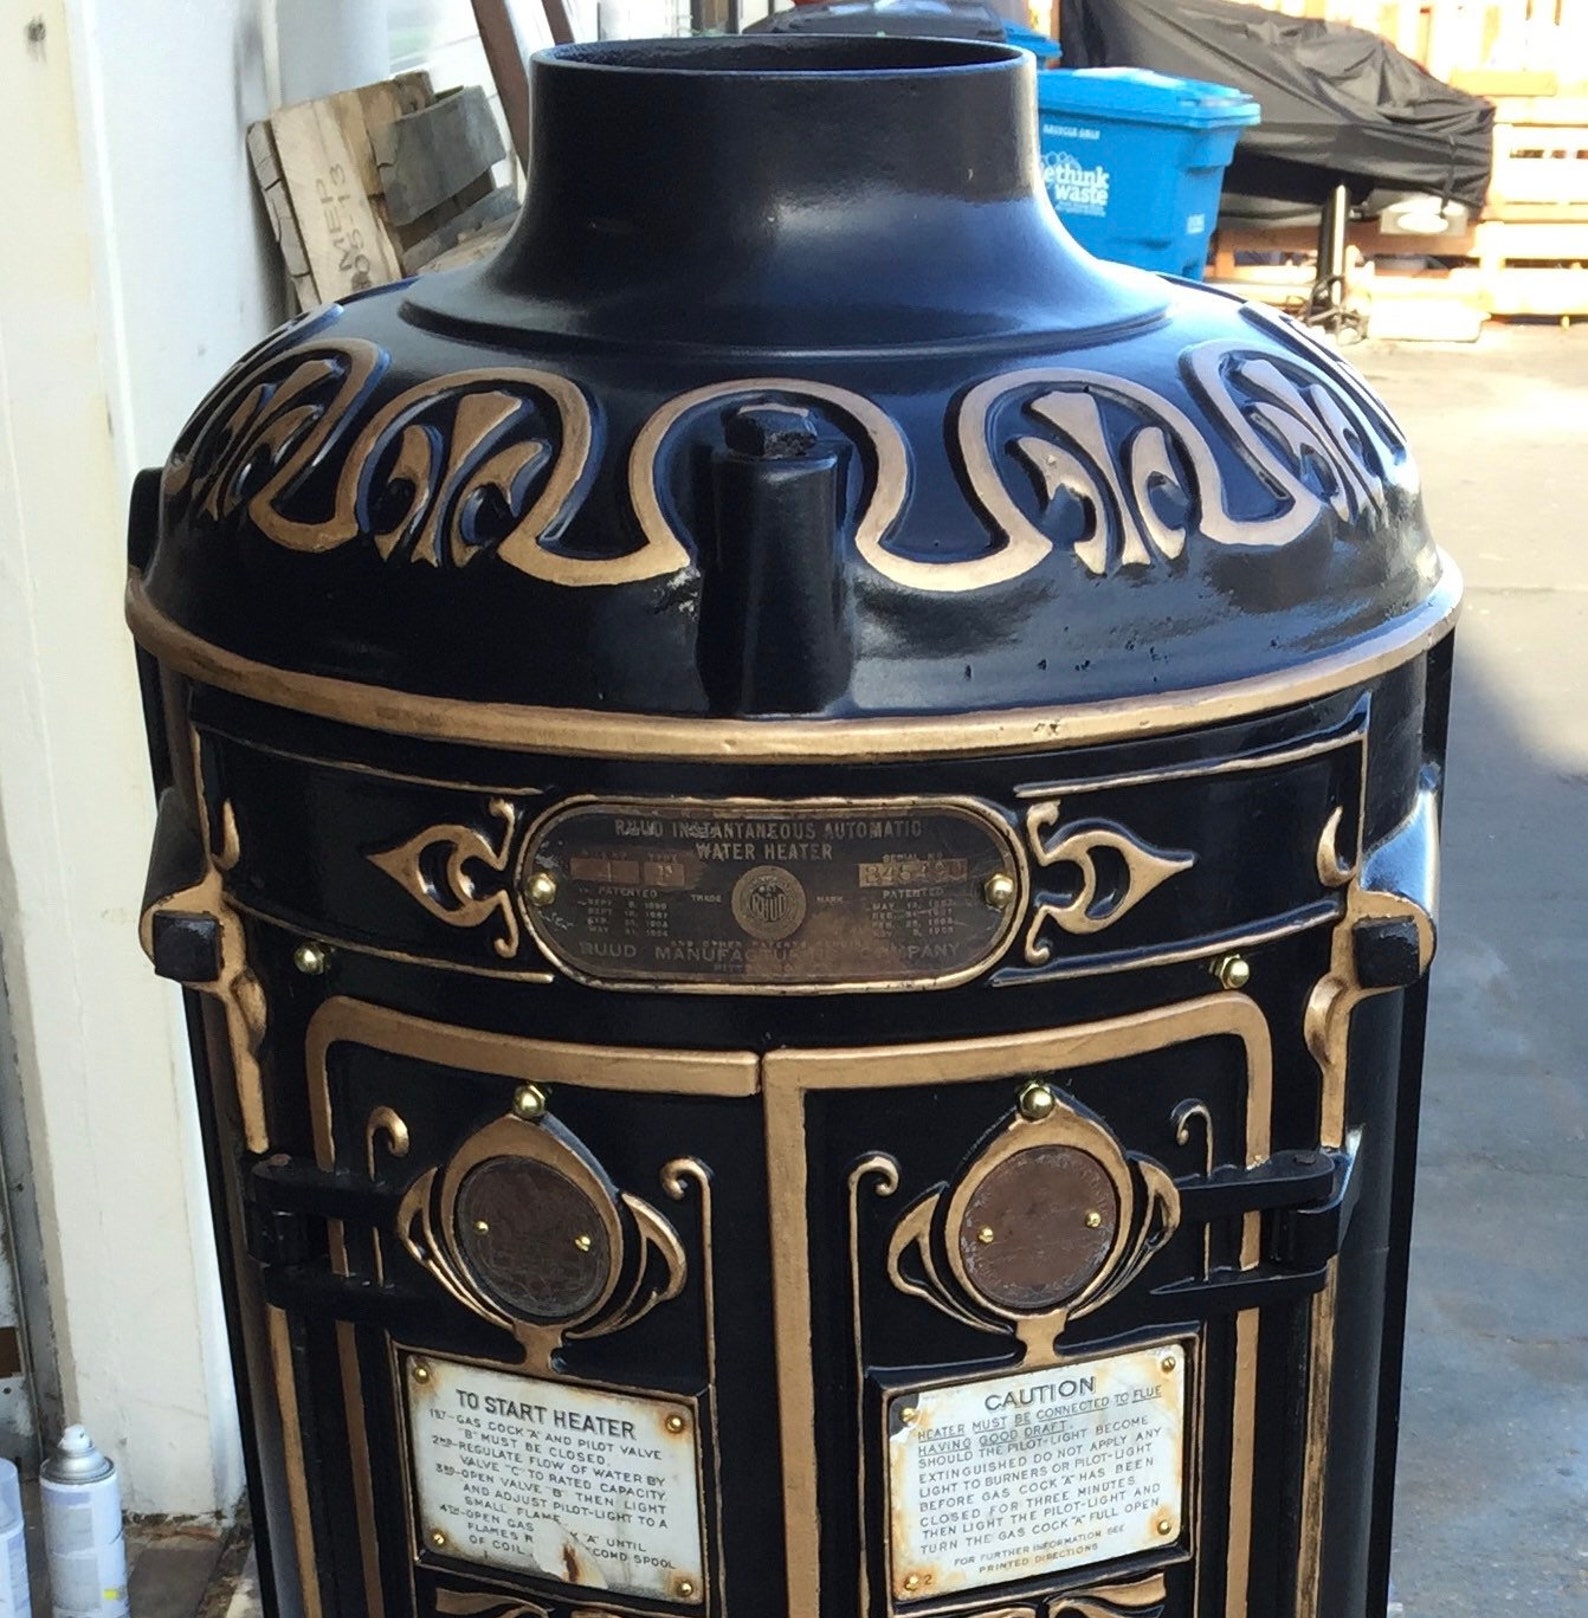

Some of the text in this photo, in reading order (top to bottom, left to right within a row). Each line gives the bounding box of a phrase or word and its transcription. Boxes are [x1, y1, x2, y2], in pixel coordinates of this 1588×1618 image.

[1042, 163, 1109, 189] ethink
[1055, 183, 1109, 206] waste
[672, 821, 816, 839] INSTANTANEOUS
[824, 820, 922, 839] AUTOMATIC
[695, 842, 832, 861] WATER HEATER
[579, 941, 637, 958] RUUD
[985, 1376, 1095, 1410] CAUTION
[456, 1389, 637, 1441] TO START HEATER
[918, 1385, 1162, 1442] HEATER MUST BE CONNECTED TO FLUE
[481, 1433, 517, 1448] MUST
[525, 1442, 542, 1454] BE
[488, 1421, 524, 1436] COCK
[545, 1433, 572, 1445] AND
[578, 1439, 614, 1452] PILOT
[620, 1445, 662, 1460] VALVE
[918, 1438, 971, 1456] HAVING
[980, 1429, 1018, 1446] GOOD
[919, 1451, 973, 1469] SHOULD
[979, 1445, 1004, 1458] THE
[1096, 1415, 1148, 1435] BECOME
[919, 1427, 1161, 1484] EXTINGUISHED DO NOT APPLY ANY
[460, 1455, 500, 1472] VALVE
[528, 1469, 544, 1481] TO
[549, 1475, 592, 1490] RATED
[529, 1456, 565, 1470] FLOW
[571, 1464, 587, 1474] OF
[593, 1468, 642, 1484] WATER
[647, 1475, 666, 1487] BY
[919, 1482, 958, 1498] LIGHT
[964, 1479, 981, 1490] TO
[985, 1466, 1048, 1487] BURNERS
[1052, 1462, 1070, 1473] OR
[920, 1494, 974, 1512] BEFORE
[981, 1488, 1010, 1502] GAS
[1019, 1479, 1057, 1494] COCK
[1080, 1468, 1105, 1481] HAS
[1115, 1457, 1154, 1474] BEEN
[463, 1483, 490, 1496] AND
[495, 1490, 548, 1508] ADJUST
[638, 1515, 655, 1527] TO
[659, 1519, 668, 1529] A
[465, 1496, 507, 1514] SMALL
[500, 1477, 542, 1494] VALVE
[576, 1492, 614, 1506] THEN
[625, 1501, 666, 1515] LIGHT
[920, 1476, 1135, 1527] CLOSED FOR THREE MINUTES
[922, 1525, 957, 1539] THEN
[963, 1517, 1004, 1533] LIGHT
[1010, 1511, 1037, 1524] THE
[1134, 1483, 1160, 1497] AND
[469, 1535, 485, 1545] OF
[507, 1518, 535, 1531] GAS
[606, 1539, 647, 1552] UNTIL
[921, 1539, 958, 1555] TURN
[966, 1534, 992, 1546] THE
[998, 1527, 1026, 1541] GAS
[1032, 1519, 1068, 1534] COCK
[1090, 1507, 1119, 1521] FULL
[1124, 1498, 1159, 1513] OPEN
[468, 1522, 519, 1540] FLAMES
[633, 1554, 676, 1570] SPOOL
[953, 1556, 976, 1566] FOR
[980, 1546, 1030, 1561] FURTHER
[1032, 1530, 1102, 1551] INFORMATION
[979, 1543, 1098, 1573] PRINTED DIRECTIONS
[924, 1574, 933, 1585] 2
